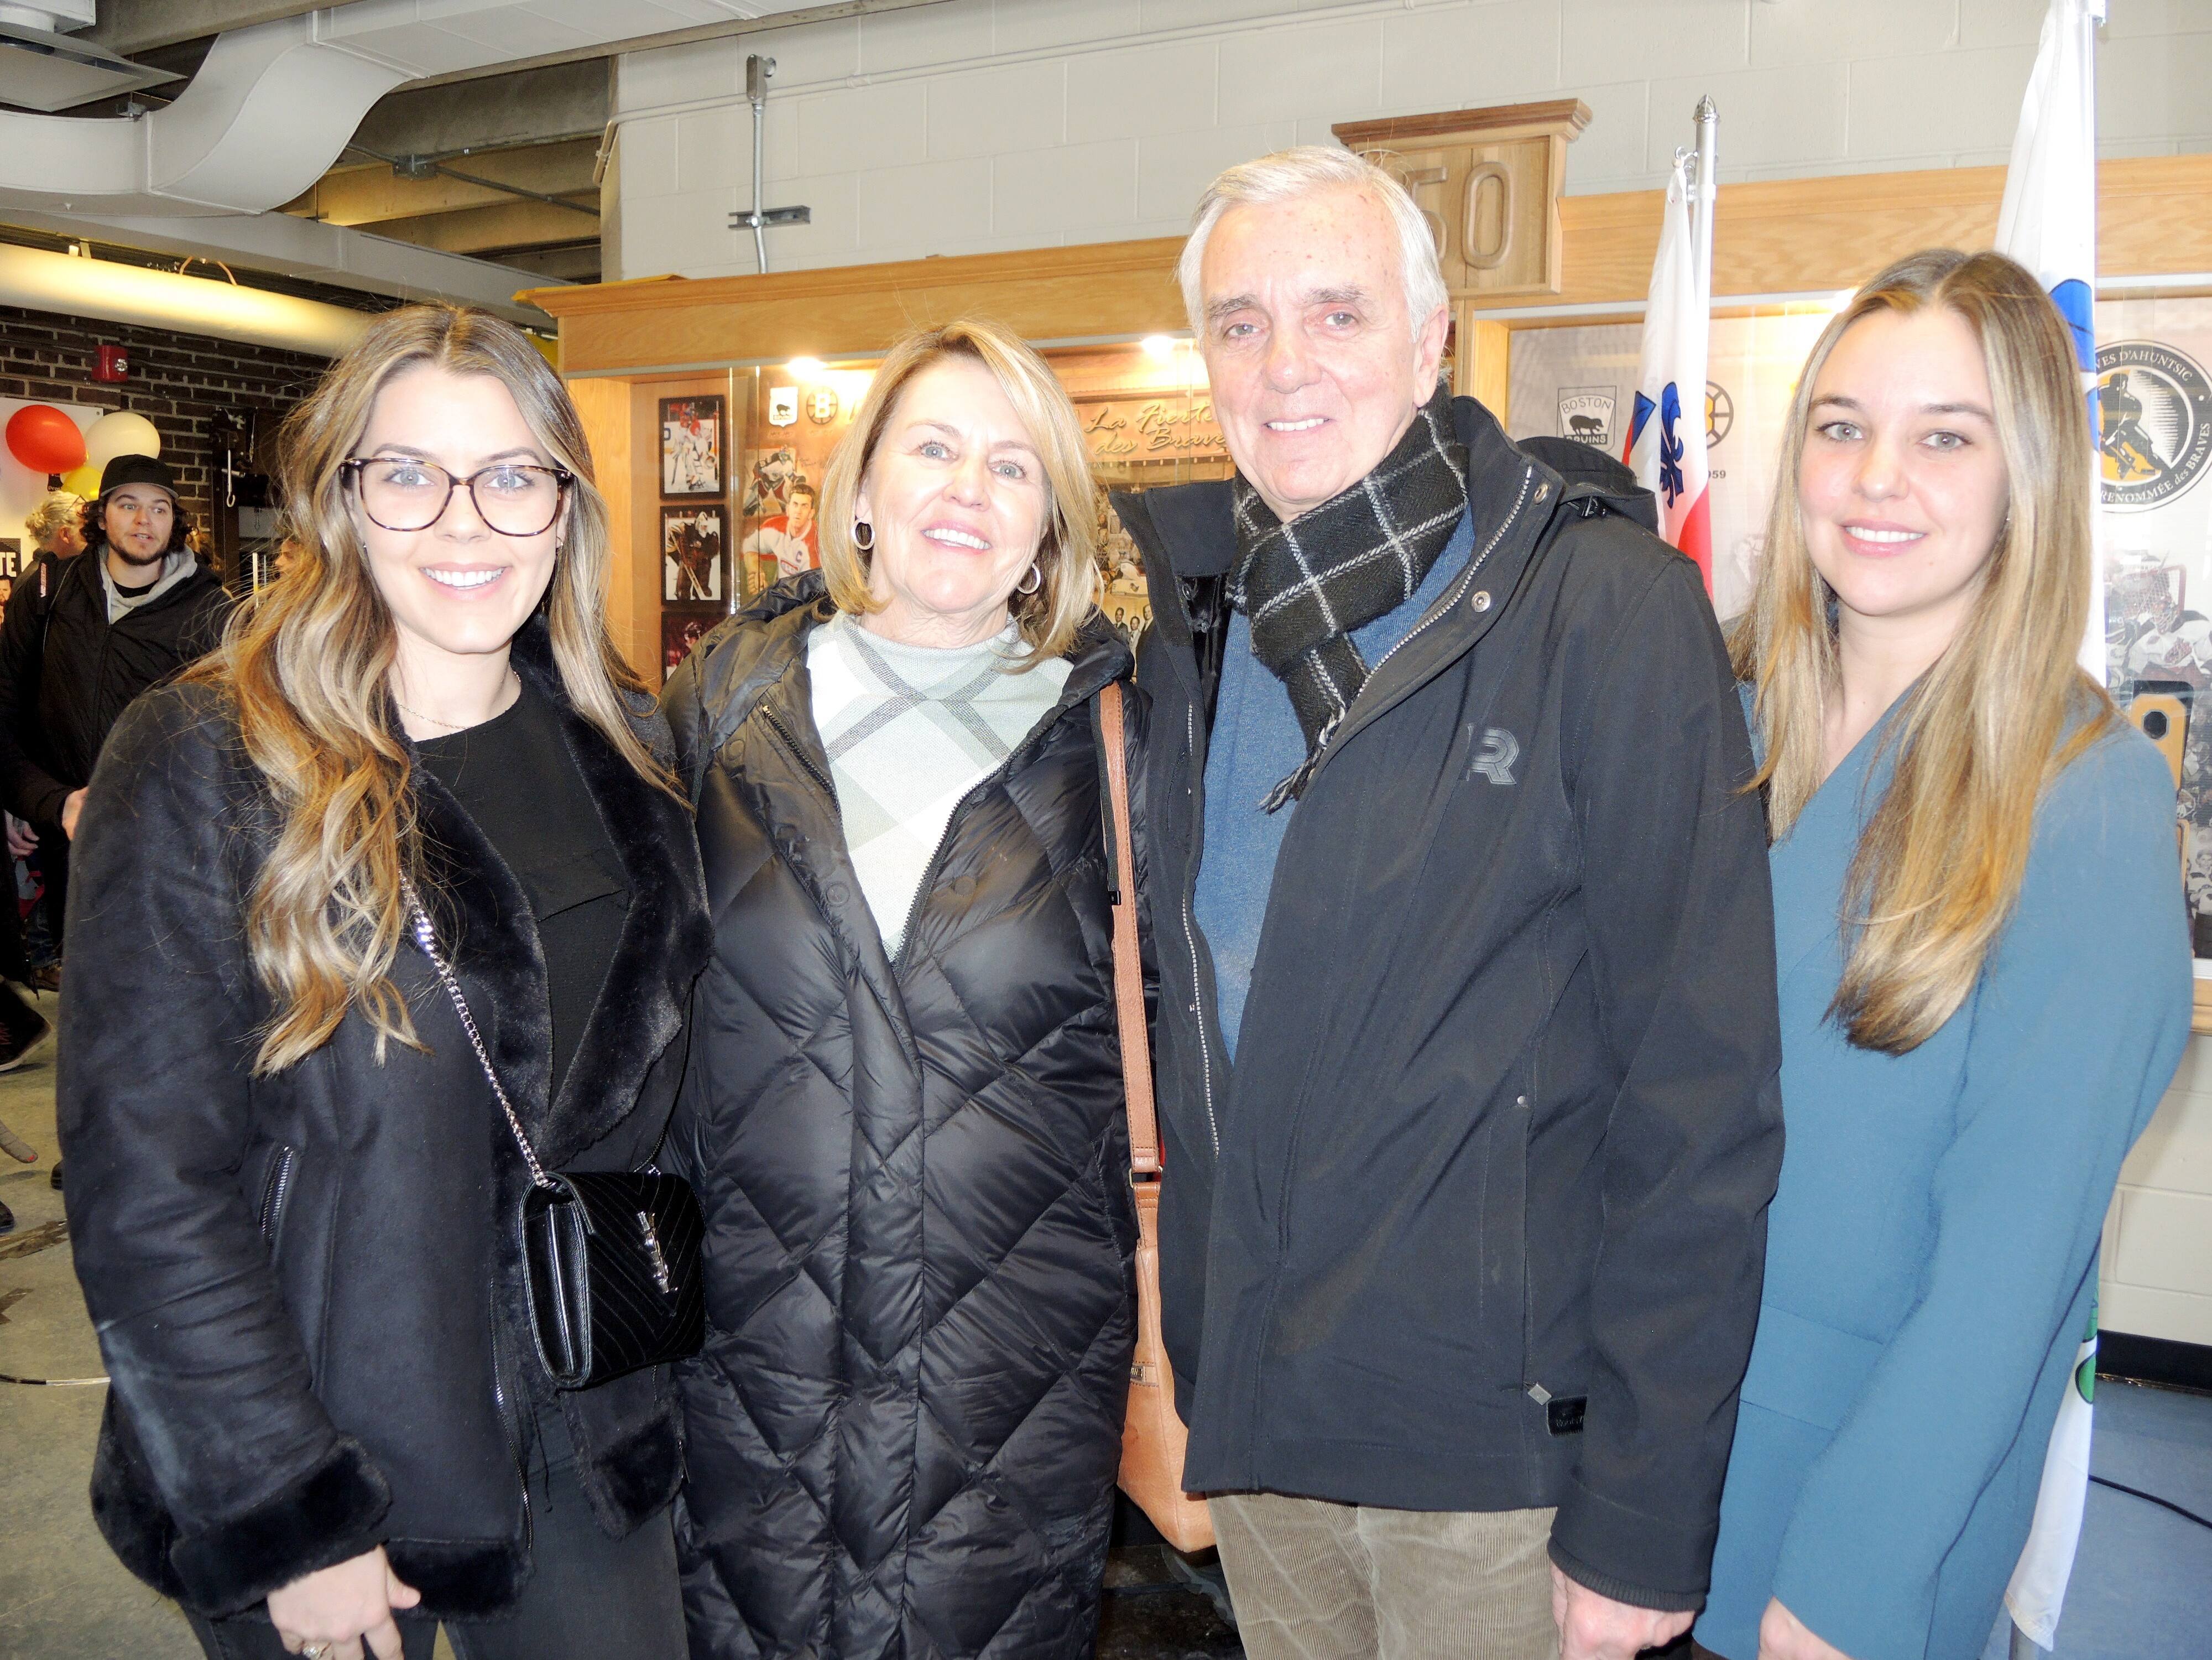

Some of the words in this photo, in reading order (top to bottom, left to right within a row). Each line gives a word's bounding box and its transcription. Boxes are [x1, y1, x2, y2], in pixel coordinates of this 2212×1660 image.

[2119, 350, 2193, 382] D'AHUNTSIC
[1561, 397, 1611, 414] BOSTON
[1084, 406, 1127, 433] La
[1095, 432, 1138, 455] des
[2174, 469, 2189, 486] des
[2185, 422, 2210, 471] BRAVES
